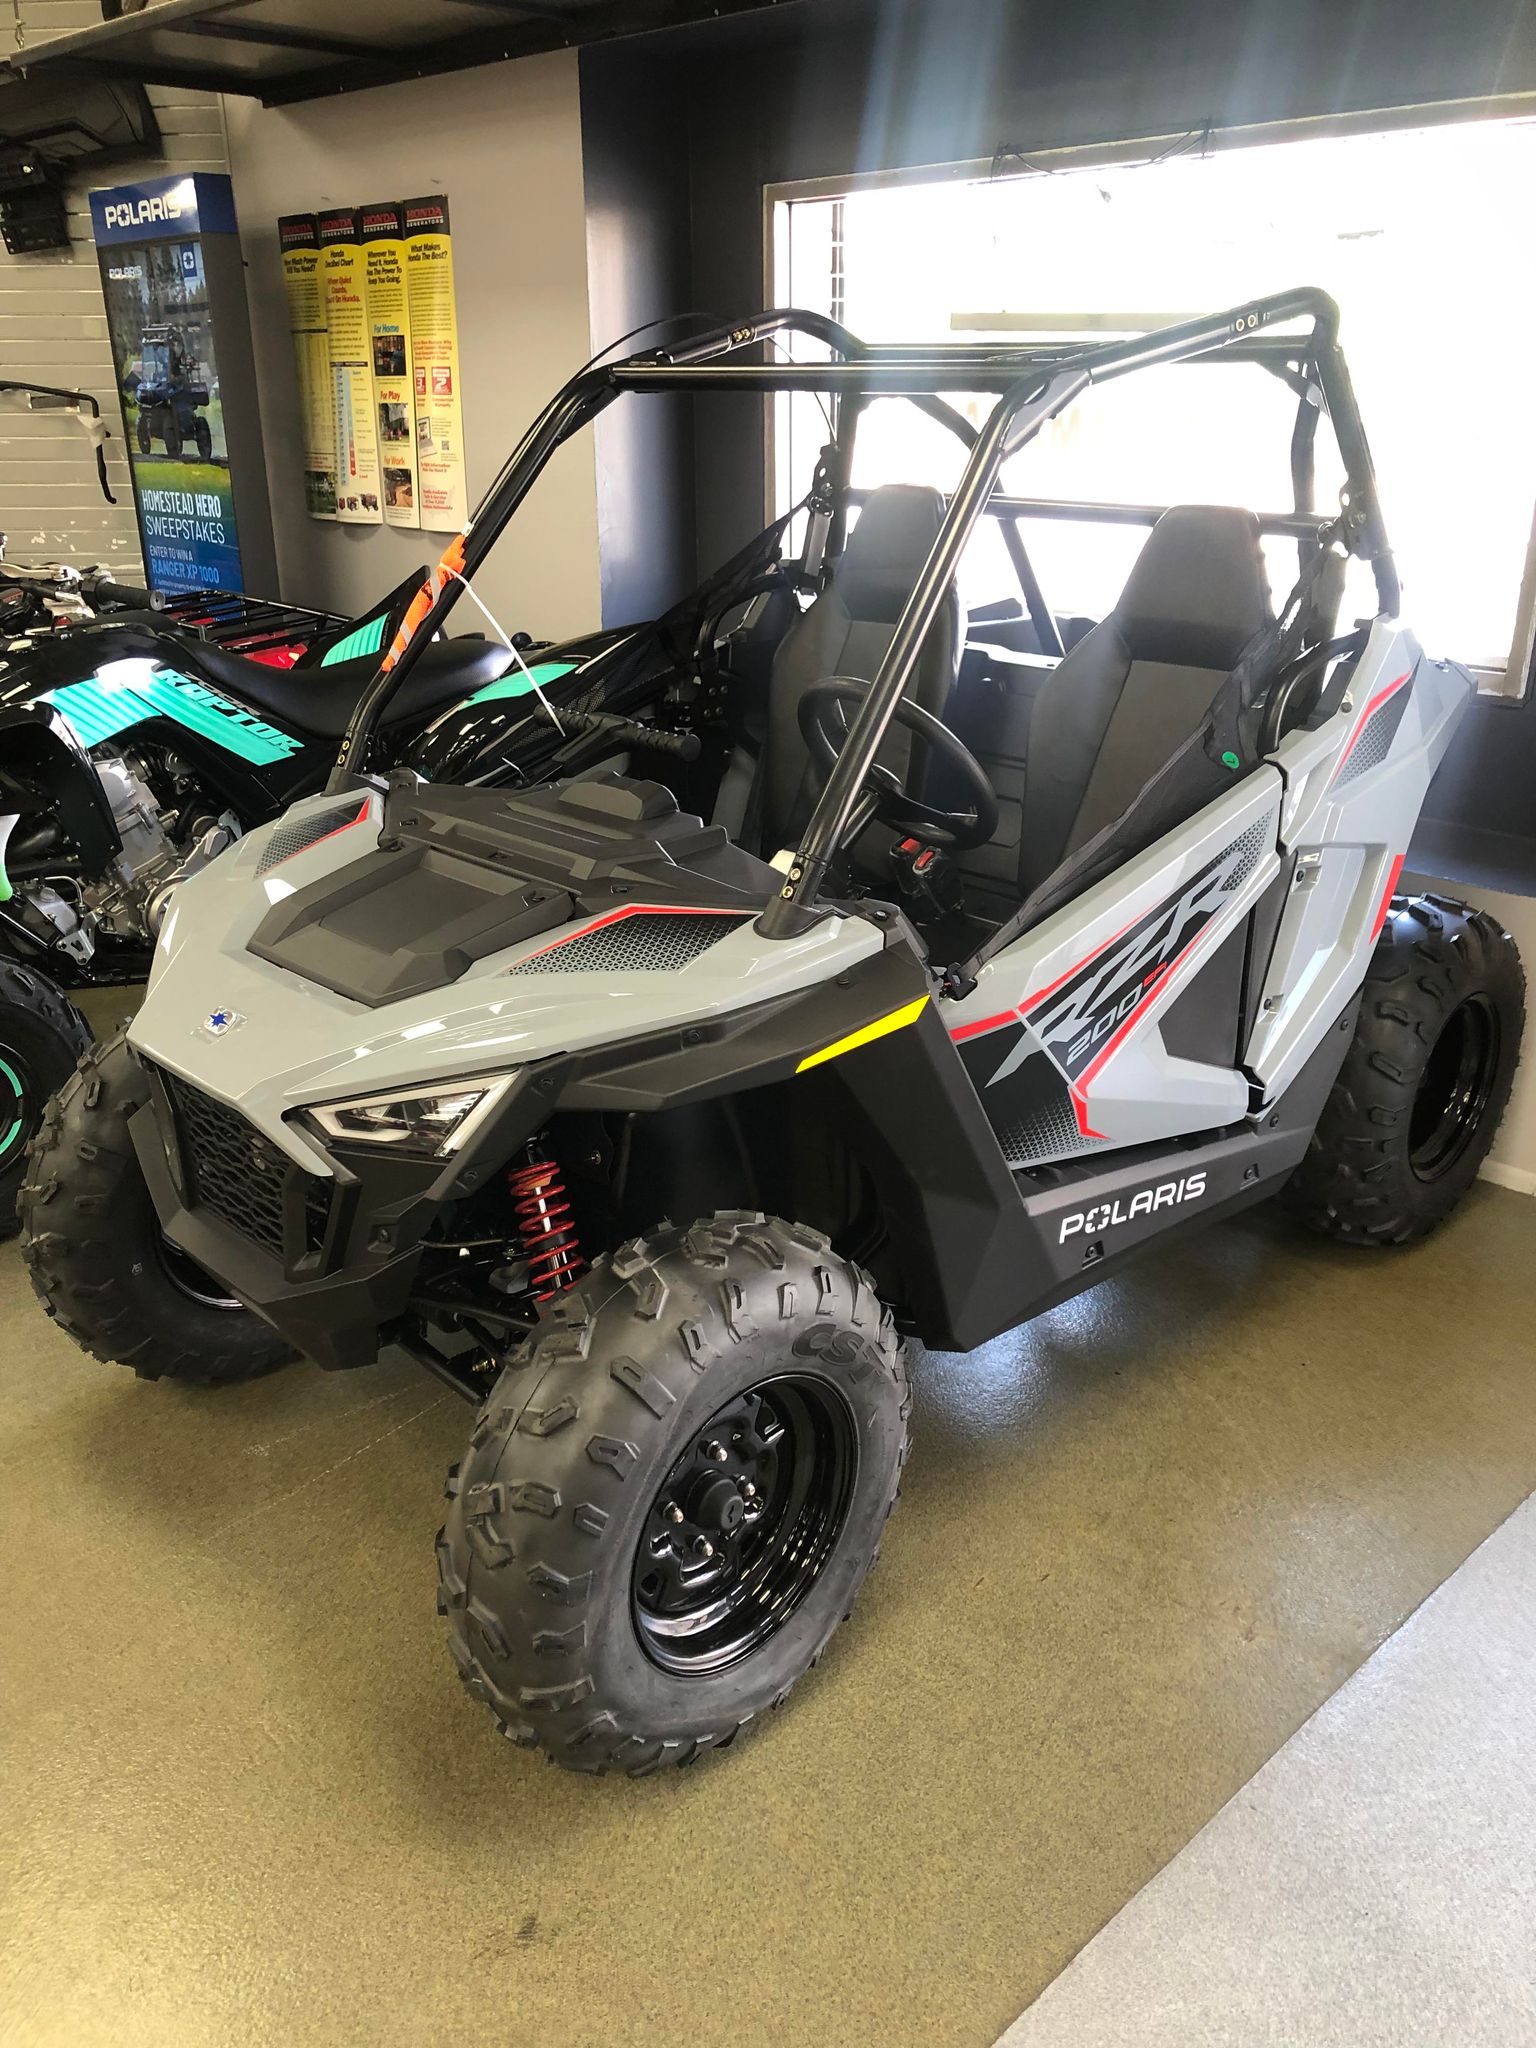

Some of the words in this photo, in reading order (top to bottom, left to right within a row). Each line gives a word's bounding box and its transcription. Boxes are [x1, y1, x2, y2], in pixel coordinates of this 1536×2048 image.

[105, 194, 181, 229] POLARIS
[406, 207, 443, 219] HONDA
[362, 212, 397, 225] HONDA
[406, 218, 444, 228] GENERATORS
[321, 218, 353, 231] HONDA
[363, 223, 398, 233] GENERATORS
[321, 229, 355, 238] GENERATORS
[410, 244, 422, 252] What
[423, 243, 441, 251] Makes
[330, 249, 344, 257] Honda
[421, 252, 431, 260] The
[431, 251, 448, 260] Best?
[303, 256, 318, 265] Power
[340, 258, 354, 266] Chart
[383, 258, 398, 266] Honda
[108, 265, 142, 280] POLARIS
[301, 264, 316, 273] Need?
[381, 266, 396, 275] Power
[339, 275, 352, 286] Quiet
[378, 276, 386, 284] You
[342, 294, 361, 303] Honda.
[382, 323, 399, 333] Home
[388, 390, 401, 402] Play
[392, 456, 405, 465] Work
[141, 489, 195, 515] HOMESTEAD
[194, 493, 222, 519] HERO
[145, 515, 225, 544] SWEEPSTAKES
[149, 544, 169, 557] ENTER
[168, 546, 176, 559] TO
[175, 548, 188, 561] WIN
[188, 550, 193, 562] A
[151, 558, 186, 579] RANGER
[186, 563, 198, 580] XP
[199, 565, 220, 584] 1000
[157, 668, 305, 753] RAPTOR
[985, 851, 1246, 1089] RZR
[1058, 1171, 1208, 1245] POLARIS
